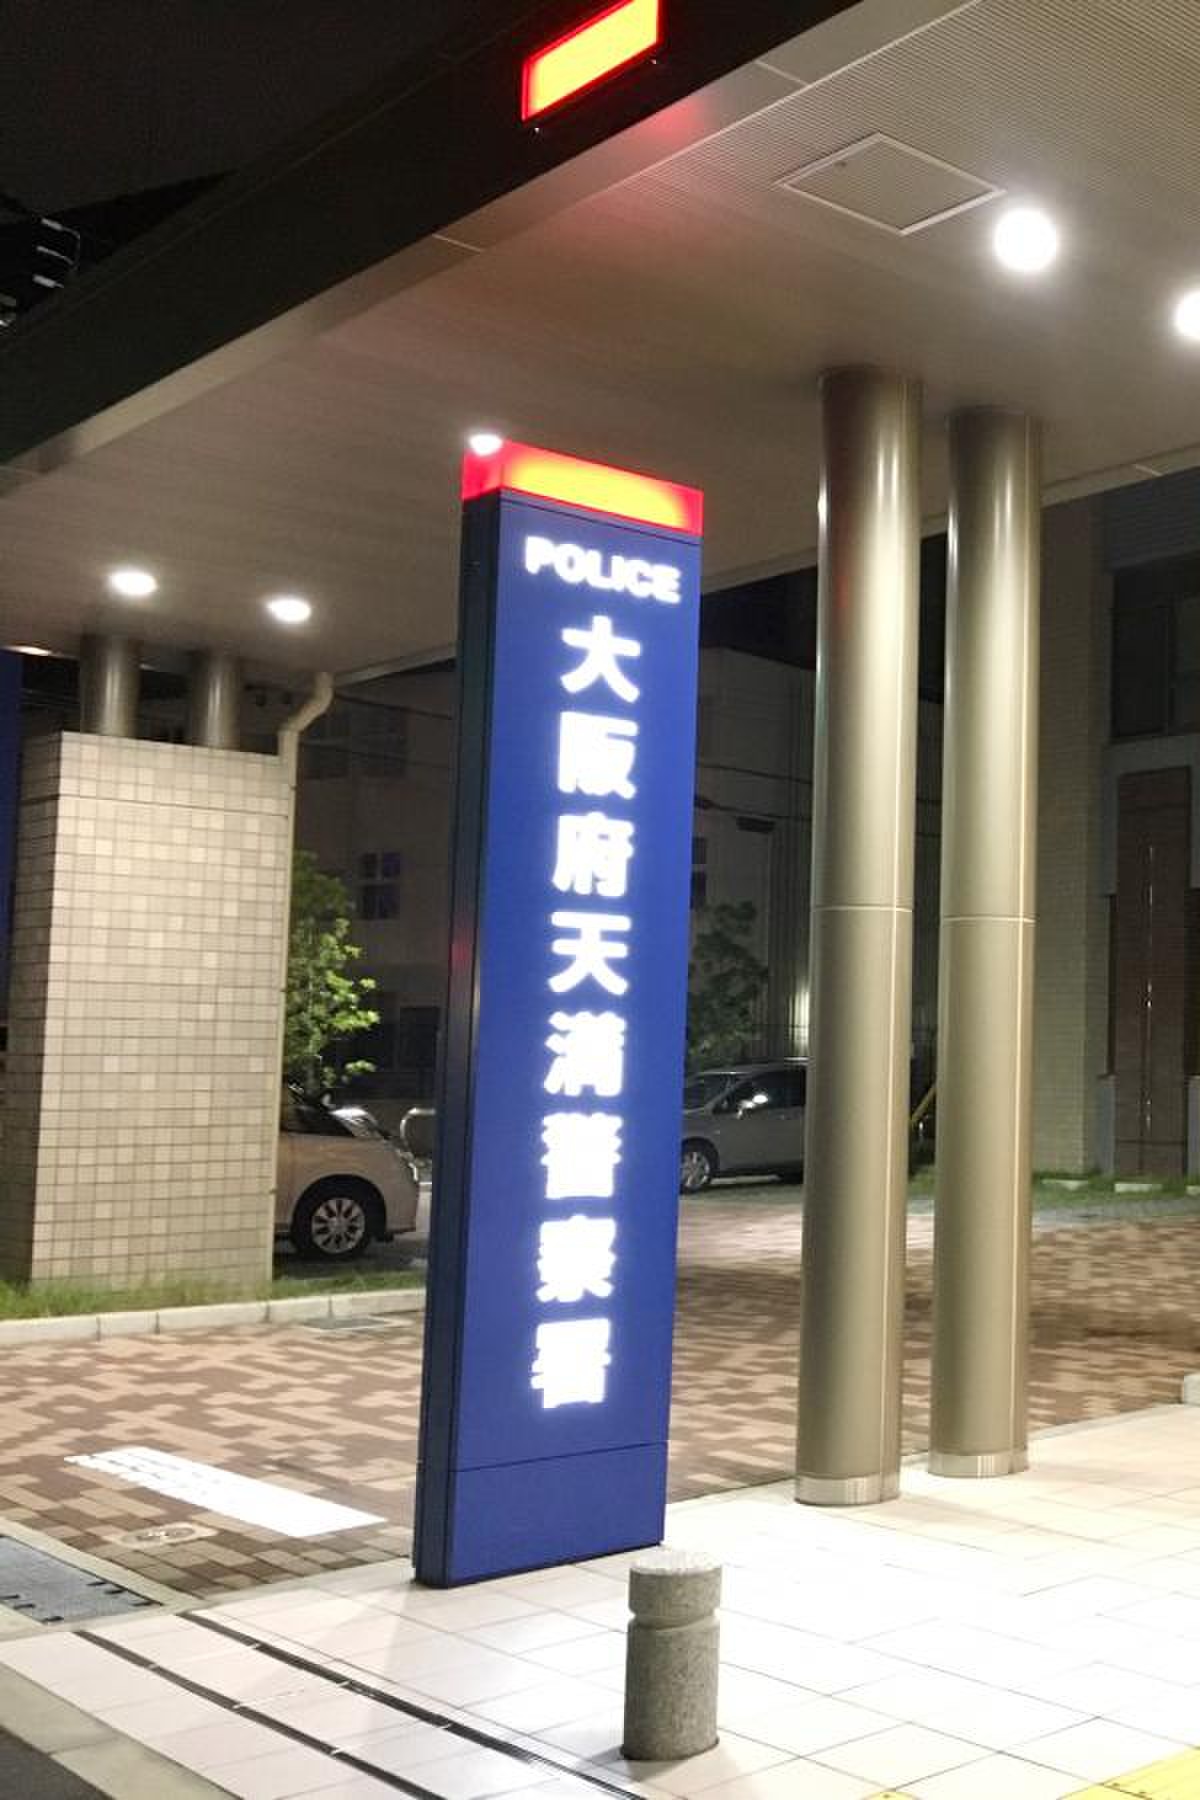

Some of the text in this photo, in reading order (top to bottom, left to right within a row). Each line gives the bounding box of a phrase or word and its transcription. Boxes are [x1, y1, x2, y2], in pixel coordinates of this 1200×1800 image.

[523, 535, 682, 604] POLICE
[529, 615, 641, 1410] 大阪府天満警察署
